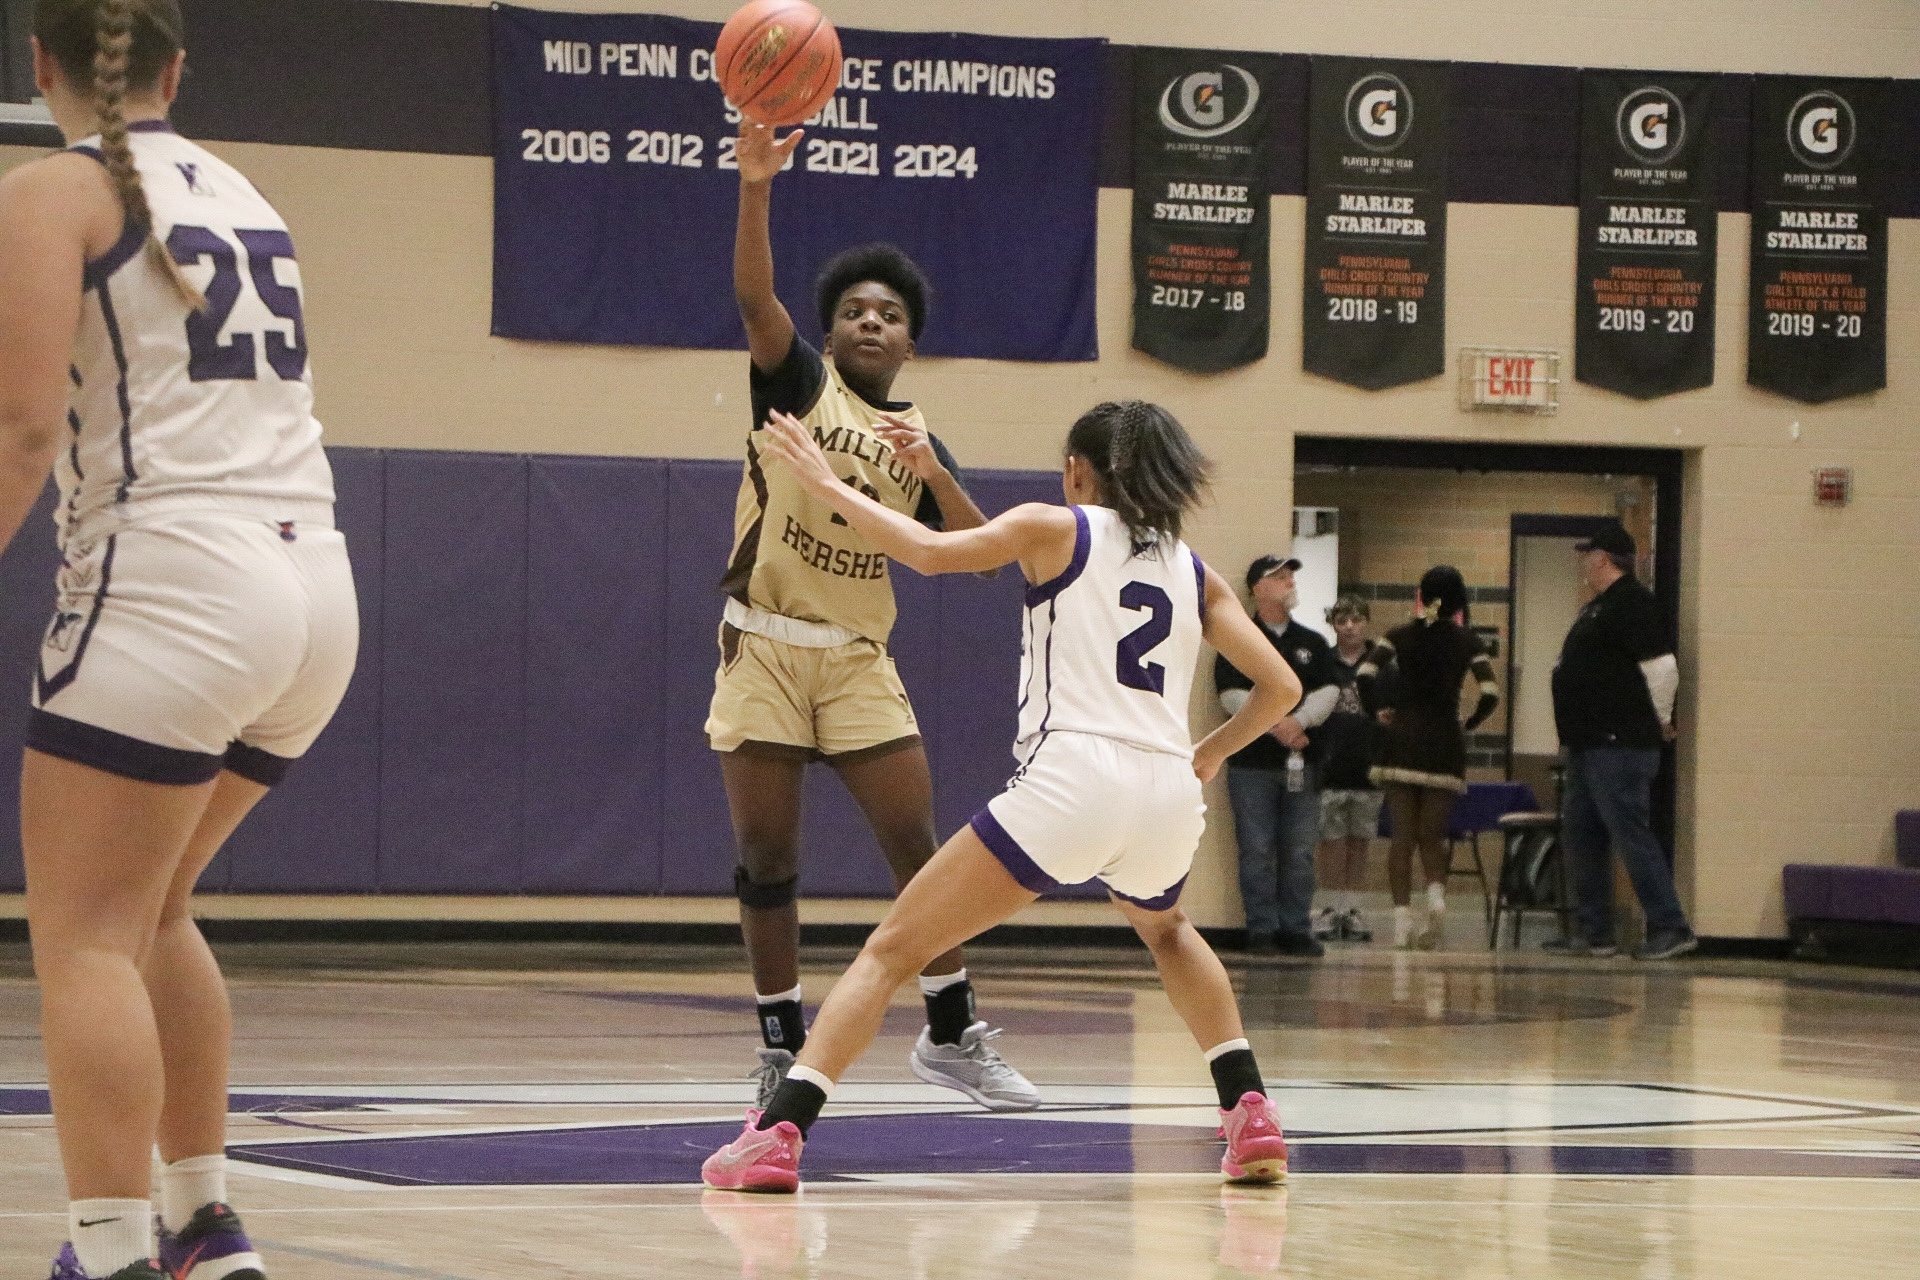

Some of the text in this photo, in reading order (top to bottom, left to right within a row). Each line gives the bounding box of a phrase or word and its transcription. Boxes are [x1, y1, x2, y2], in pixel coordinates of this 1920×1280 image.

[543, 40, 592, 74] MID
[600, 43, 677, 78] PENN
[893, 59, 1056, 99] CHAMPIONS
[521, 128, 611, 164] 2006
[626, 130, 704, 168] 2012
[807, 138, 880, 176] 2021
[894, 144, 978, 179] 2024
[1343, 156, 1414, 168] PLAYER OF THE YEAR
[1614, 168, 1688, 180] PLAYER OF THE YEAR
[1784, 173, 1857, 185] PLAYER OF THE YEAR
[1168, 182, 1248, 202] MARLEE
[1340, 194, 1414, 214] MARLEE
[1326, 215, 1426, 236] STARLIPER
[1609, 206, 1686, 224] MARLEE
[1780, 211, 1859, 229] MARLEE
[1598, 226, 1698, 246] STARLIPER
[1766, 231, 1868, 250] STARLIPER
[166, 224, 307, 381] 25
[1151, 285, 1204, 309] 2017
[1224, 291, 1245, 311] 18
[1328, 298, 1378, 321] 2018
[1398, 301, 1417, 324] 19
[1599, 307, 1645, 331] 2019
[1667, 310, 1694, 333] 20
[1768, 312, 1814, 336] 2019
[1837, 315, 1861, 338] 20
[1489, 358, 1535, 396] EXIT
[813, 426, 922, 503] MILTON
[781, 514, 886, 580] HERSHE
[1116, 580, 1173, 698] 2
